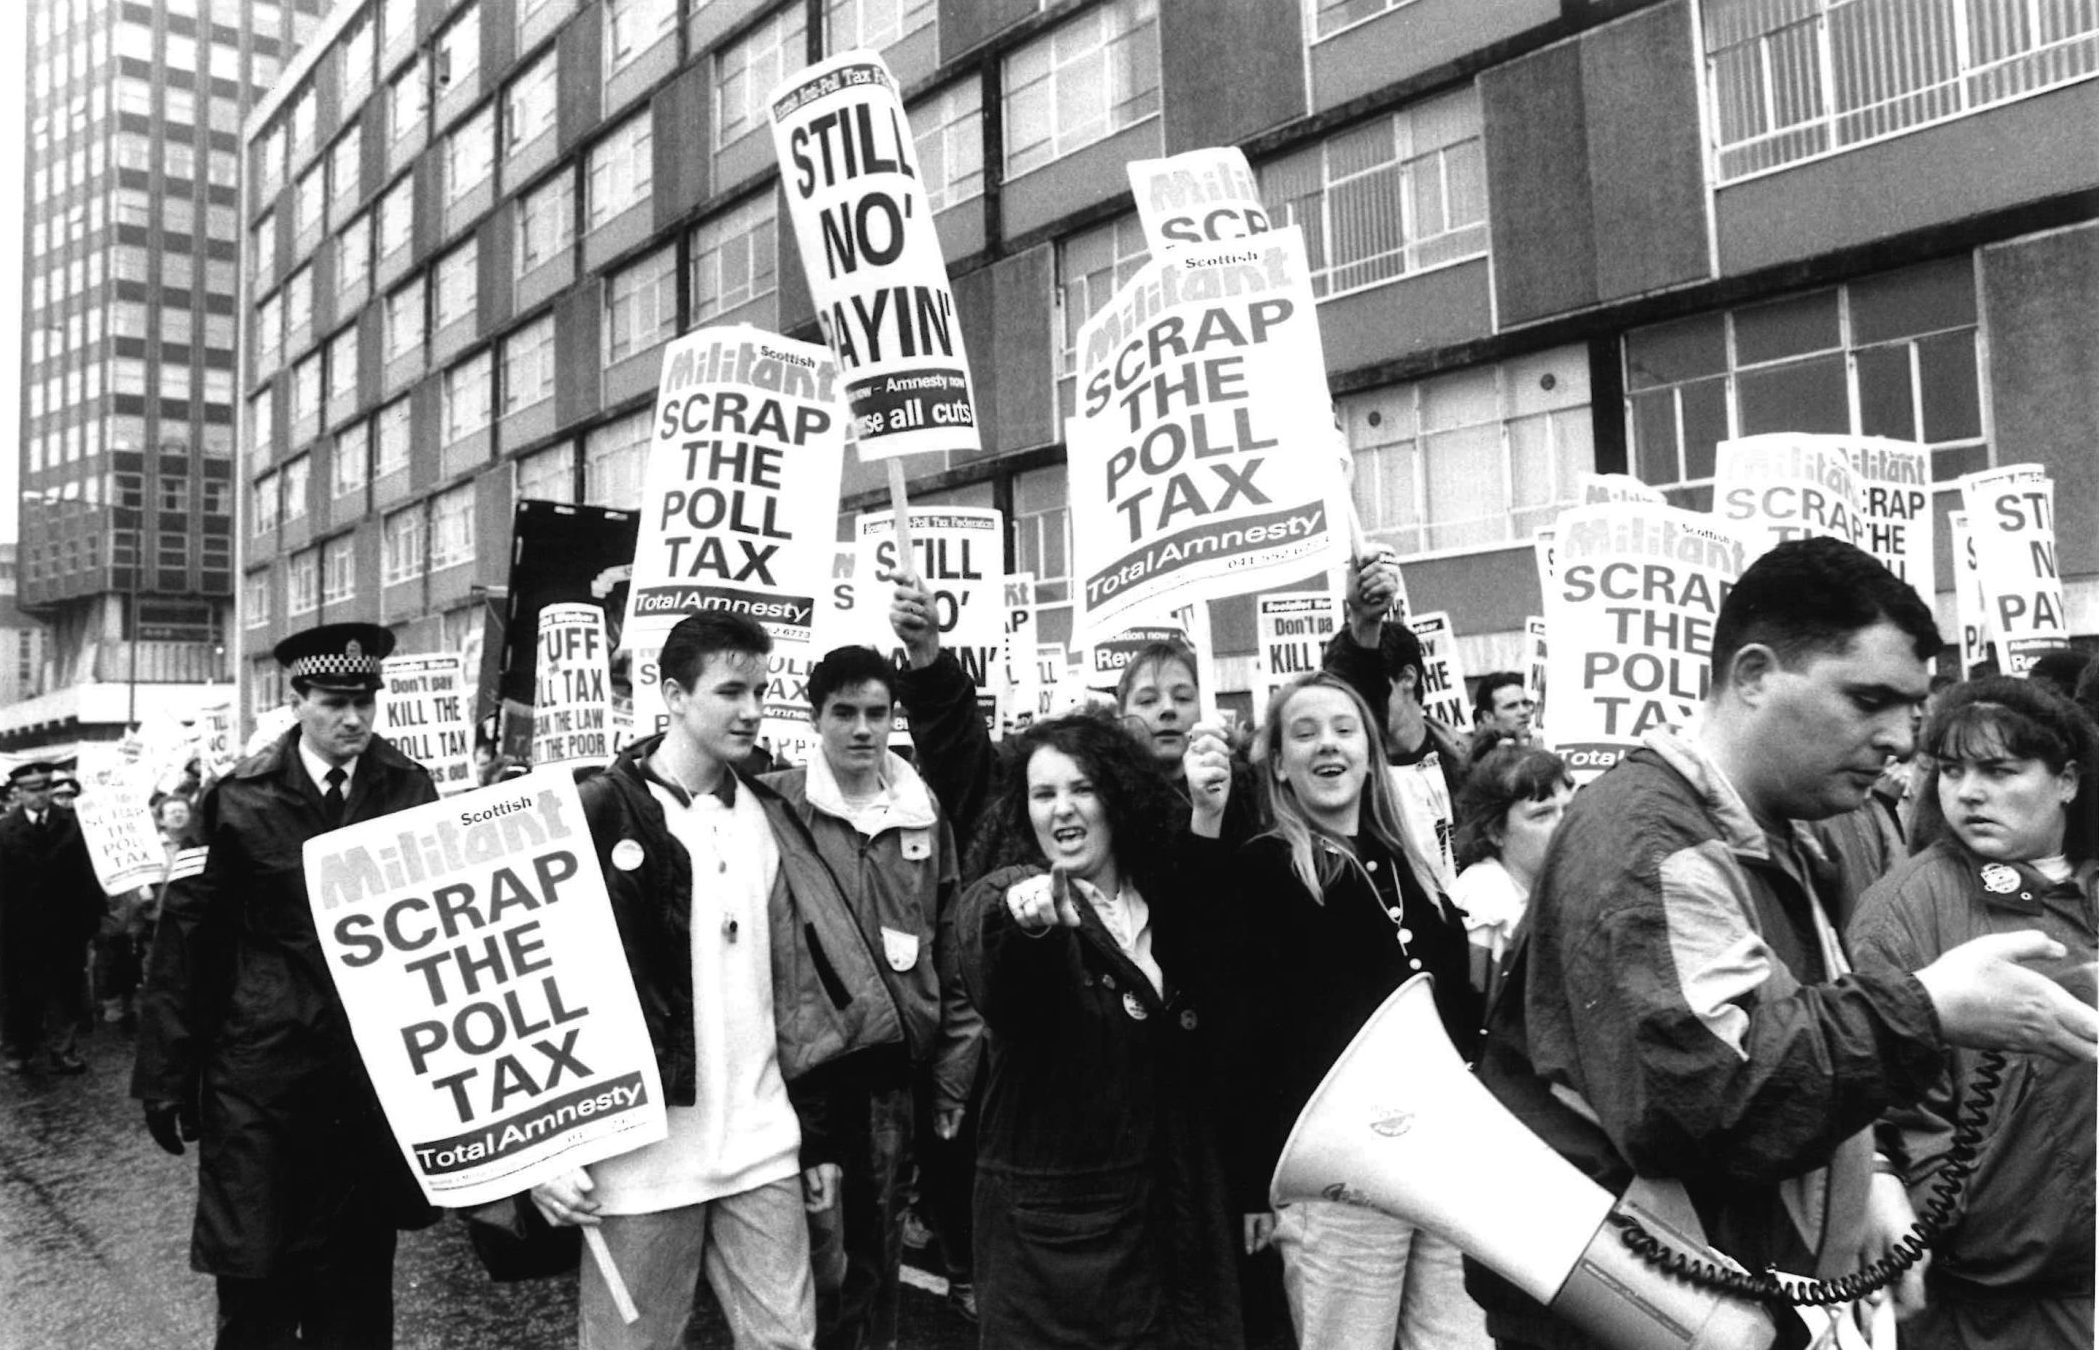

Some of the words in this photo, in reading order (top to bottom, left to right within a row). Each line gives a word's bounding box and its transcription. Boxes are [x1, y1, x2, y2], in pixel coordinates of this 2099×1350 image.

[842, 67, 871, 86] Tax
[790, 103, 915, 199] STILL
[820, 191, 912, 279] NO'
[1185, 251, 1258, 268] Scottish
[1085, 246, 1293, 376] Militant
[665, 342, 838, 403] Militant
[760, 345, 816, 368] Scottish
[1084, 298, 1295, 419] SCRAP
[886, 373, 947, 394] Amnesty
[1120, 355, 1249, 434] THE
[660, 392, 831, 446] SCRAP
[890, 398, 925, 428] all
[932, 399, 973, 425] cuts
[682, 440, 784, 490] THE
[1106, 406, 1280, 503] POLL
[660, 487, 793, 541] POLL
[1116, 457, 1273, 543] TAX
[1725, 486, 1864, 545] SCRAP
[1861, 486, 1926, 521] RAP
[1086, 551, 1154, 603] Total
[1155, 510, 1323, 570] Amnesty
[1564, 516, 1746, 578] Militant
[1865, 522, 1907, 555] HE
[664, 536, 781, 587] TAX
[635, 591, 680, 611] Total
[680, 591, 812, 623] Amnesty
[932, 589, 970, 633] O'
[1275, 615, 1314, 636] Don't
[1317, 616, 1334, 636] pa
[538, 627, 599, 662] UFF
[1605, 607, 1712, 660] THE
[1269, 641, 1315, 675] KILL
[1421, 660, 1452, 693] HE
[390, 674, 429, 695] Don't
[562, 668, 605, 704] TAX
[766, 678, 811, 701] AX
[386, 699, 429, 728] KILL
[433, 695, 462, 723] THE
[554, 710, 573, 732] THE
[575, 708, 604, 730] LAW
[1422, 697, 1466, 728] TAX
[1593, 696, 1694, 737] TA
[438, 729, 468, 757] TAX
[545, 736, 565, 759] THE
[567, 732, 607, 757] POOR
[460, 795, 532, 826] Scottish
[320, 788, 572, 910] Militant
[332, 849, 579, 969] SCRAP
[404, 919, 554, 1008] THE
[399, 975, 590, 1076] POLL
[431, 1027, 596, 1125] TAX
[417, 1132, 497, 1170] Total
[497, 1080, 643, 1152] Amnesty
